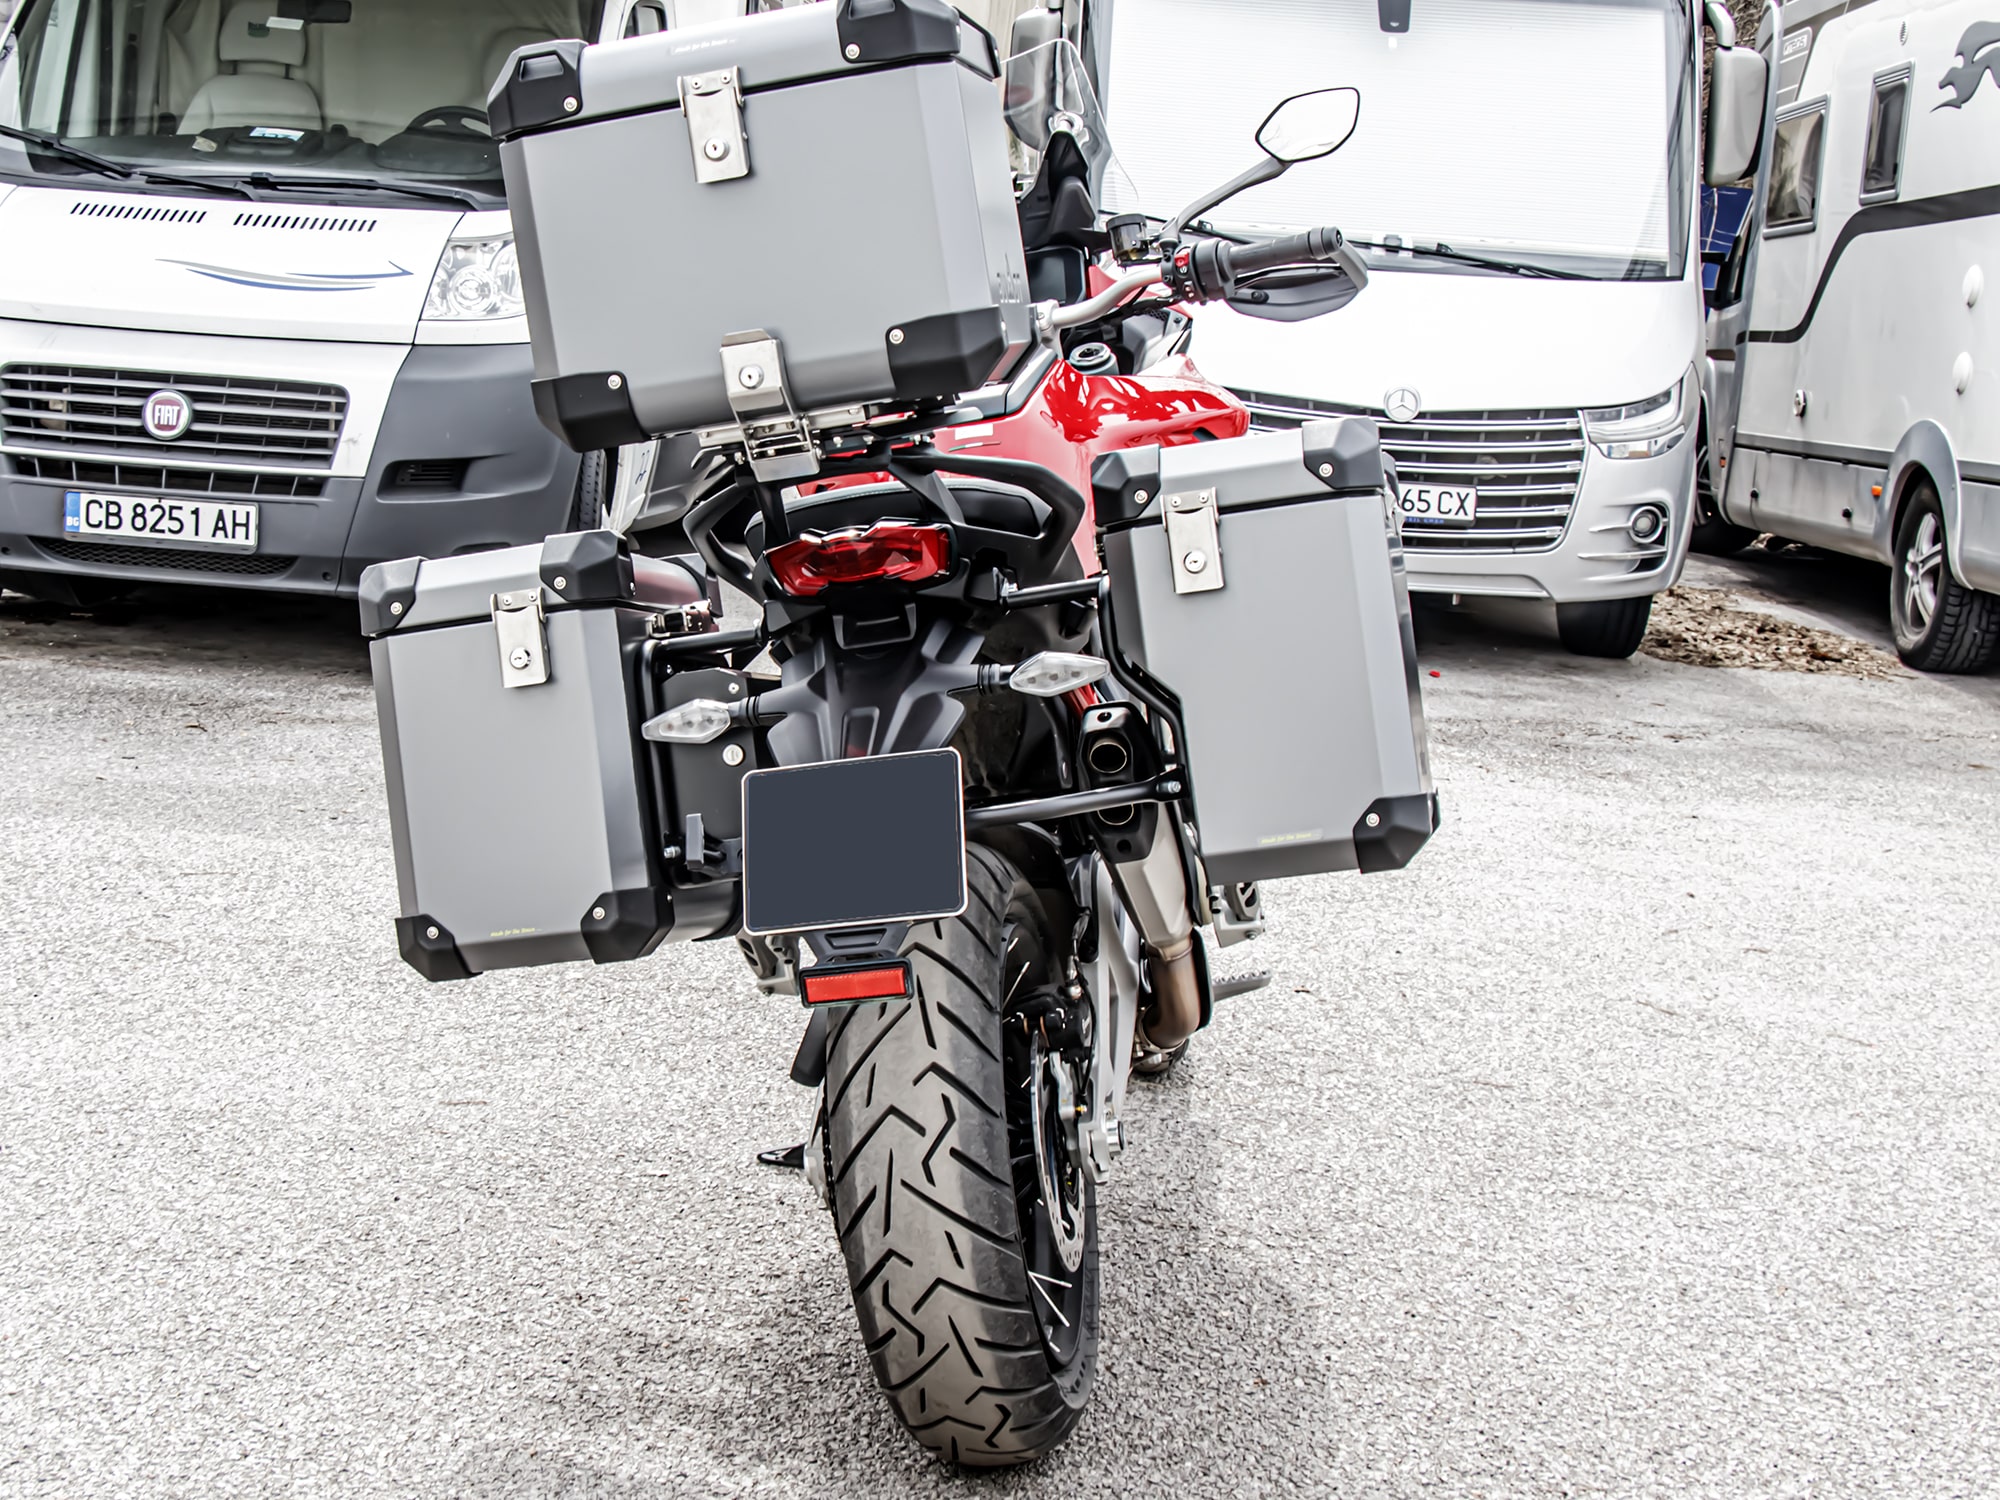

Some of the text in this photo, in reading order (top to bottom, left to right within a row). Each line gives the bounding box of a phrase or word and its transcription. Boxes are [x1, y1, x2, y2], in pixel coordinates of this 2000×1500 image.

[154, 405, 180, 426] FIAT
[1401, 488, 1470, 516] 65 CX
[66, 516, 79, 527] BG
[85, 499, 250, 540] CB 8251 AH
